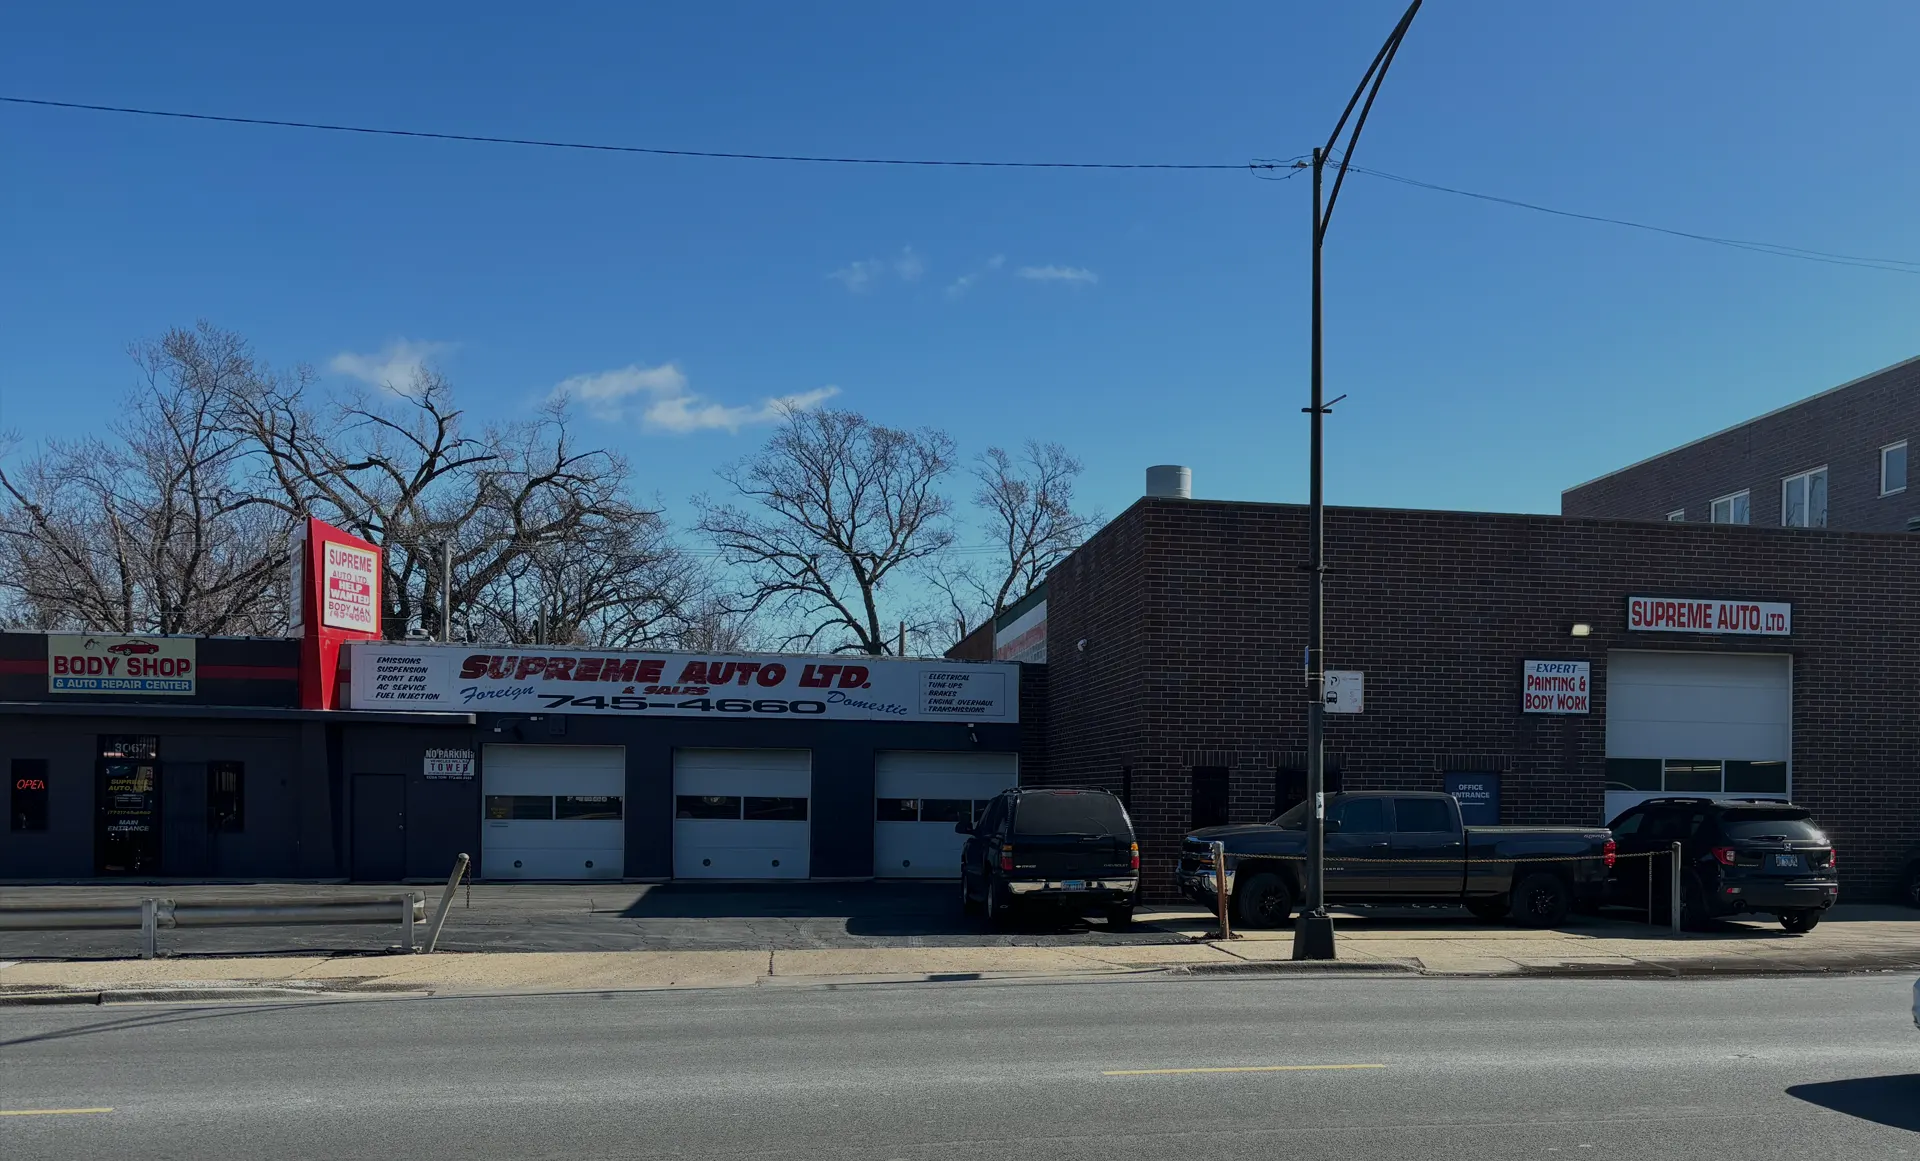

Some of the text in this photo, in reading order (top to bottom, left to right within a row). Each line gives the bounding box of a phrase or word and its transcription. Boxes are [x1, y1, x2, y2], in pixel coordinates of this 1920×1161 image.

[329, 549, 372, 573] SUPREME
[332, 570, 352, 581] AUTO
[338, 580, 363, 593] HELP
[330, 588, 370, 605] WANTED
[329, 601, 371, 617] BODY MAN
[1631, 600, 1788, 633] SUPREME AUTO, LTD.
[54, 655, 192, 677] BODY SHOP
[376, 656, 422, 665] EMISSIONS
[376, 666, 429, 674] SUSPENSION
[459, 654, 872, 689] SUPREME AUTO LTD.
[1536, 663, 1579, 674] EXPERT
[376, 674, 427, 683] FRONT END
[928, 673, 970, 681] ELECTRICAL
[56, 679, 190, 690] & AUTO REPAIR CENTER
[376, 683, 427, 692] AC SERVICE
[928, 681, 963, 689] TUNE-UPS
[1527, 675, 1586, 692] PAINTING &
[375, 692, 440, 700] FUEL INJECTION
[460, 685, 536, 704] Foreign
[622, 685, 711, 696] & SALES
[928, 689, 958, 697] BRAKES
[537, 694, 827, 714] 745-4660
[827, 691, 909, 716] Domestic
[1525, 693, 1587, 711] BODY WORK
[928, 705, 986, 713] TRANSMISSIONS
[426, 749, 475, 759] NO PARKING
[16, 779, 45, 790] OPEN
[1451, 791, 1490, 799] ENTRANCE
